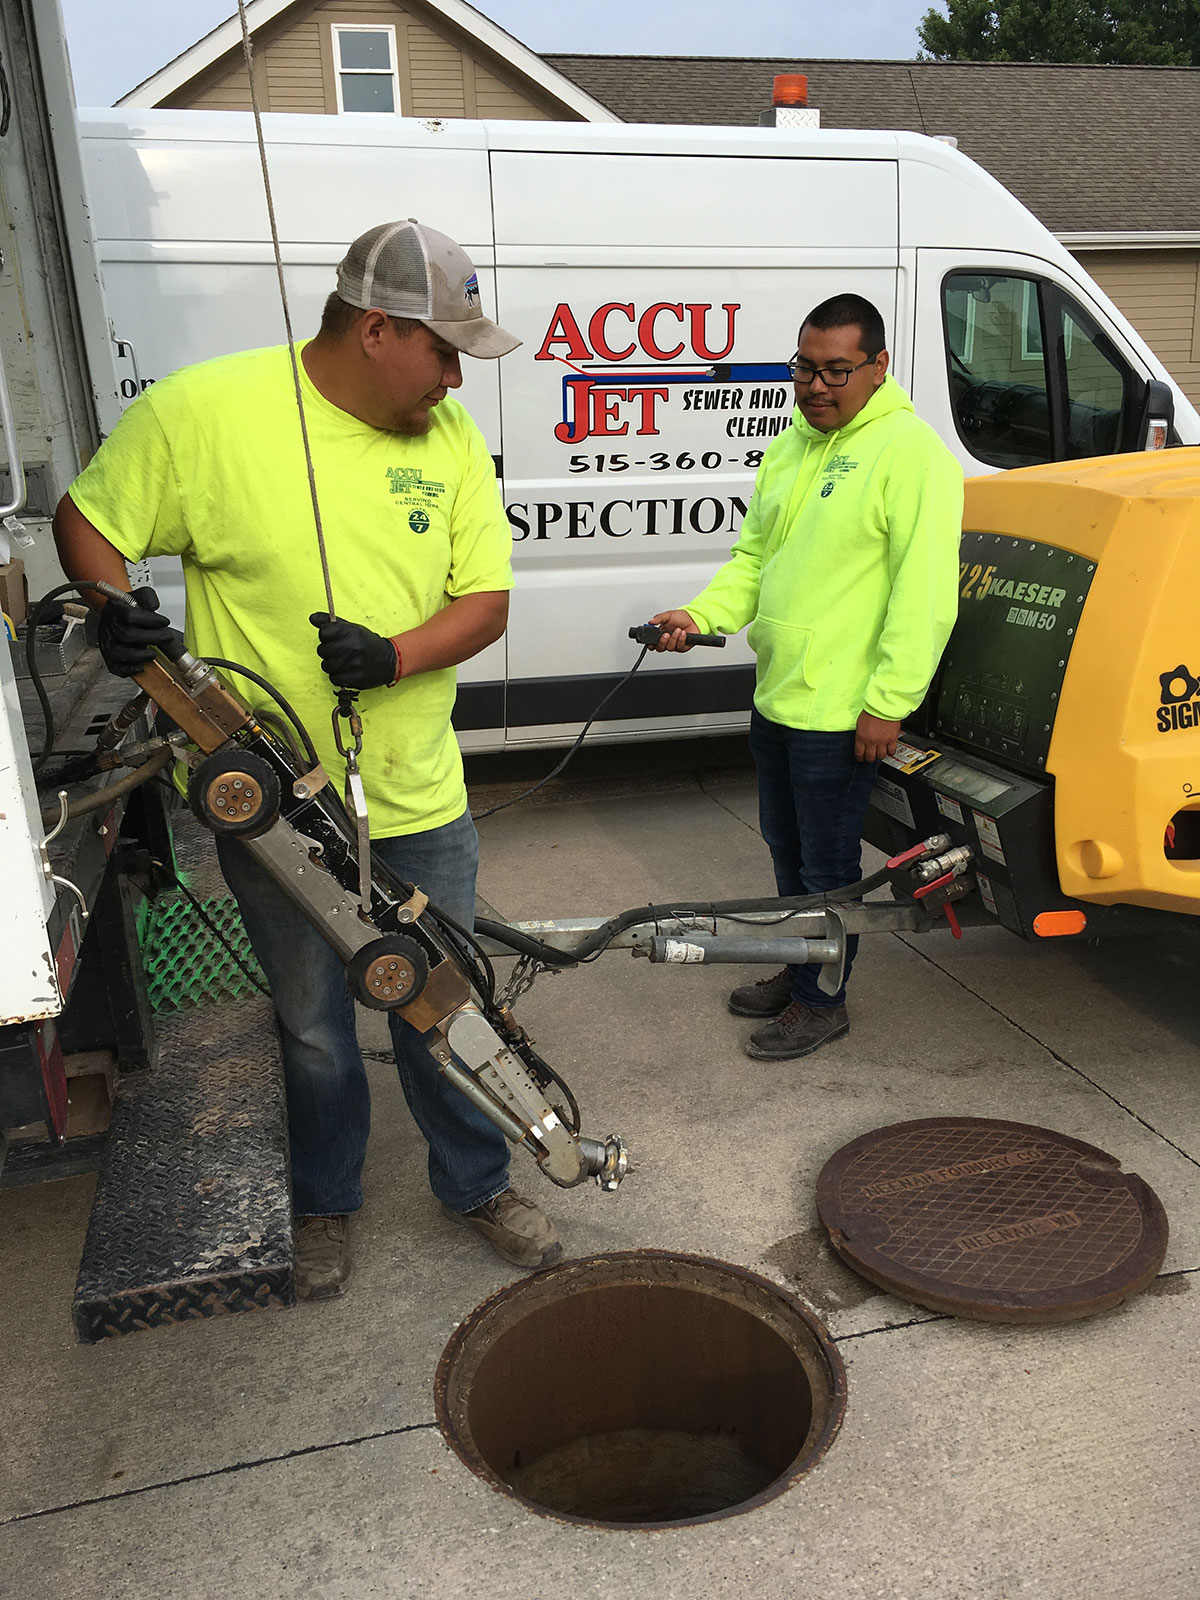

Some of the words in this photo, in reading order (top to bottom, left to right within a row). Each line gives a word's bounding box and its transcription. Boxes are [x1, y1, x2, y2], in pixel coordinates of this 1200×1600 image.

[534, 302, 741, 362] ACCU
[683, 387, 743, 411] SEWER
[749, 387, 787, 409] AND
[554, 380, 669, 444] JET
[726, 416, 793, 437] CLEANI
[385, 466, 423, 481] ACCU
[389, 480, 412, 494] JET
[412, 513, 427, 521] 24
[416, 524, 424, 532] 7
[987, 578, 1067, 608] KAESER
[865, 1174, 935, 1197] NEENAH
[939, 1157, 1011, 1179] FOUNDRY
[961, 1223, 1038, 1250] NEENAH
